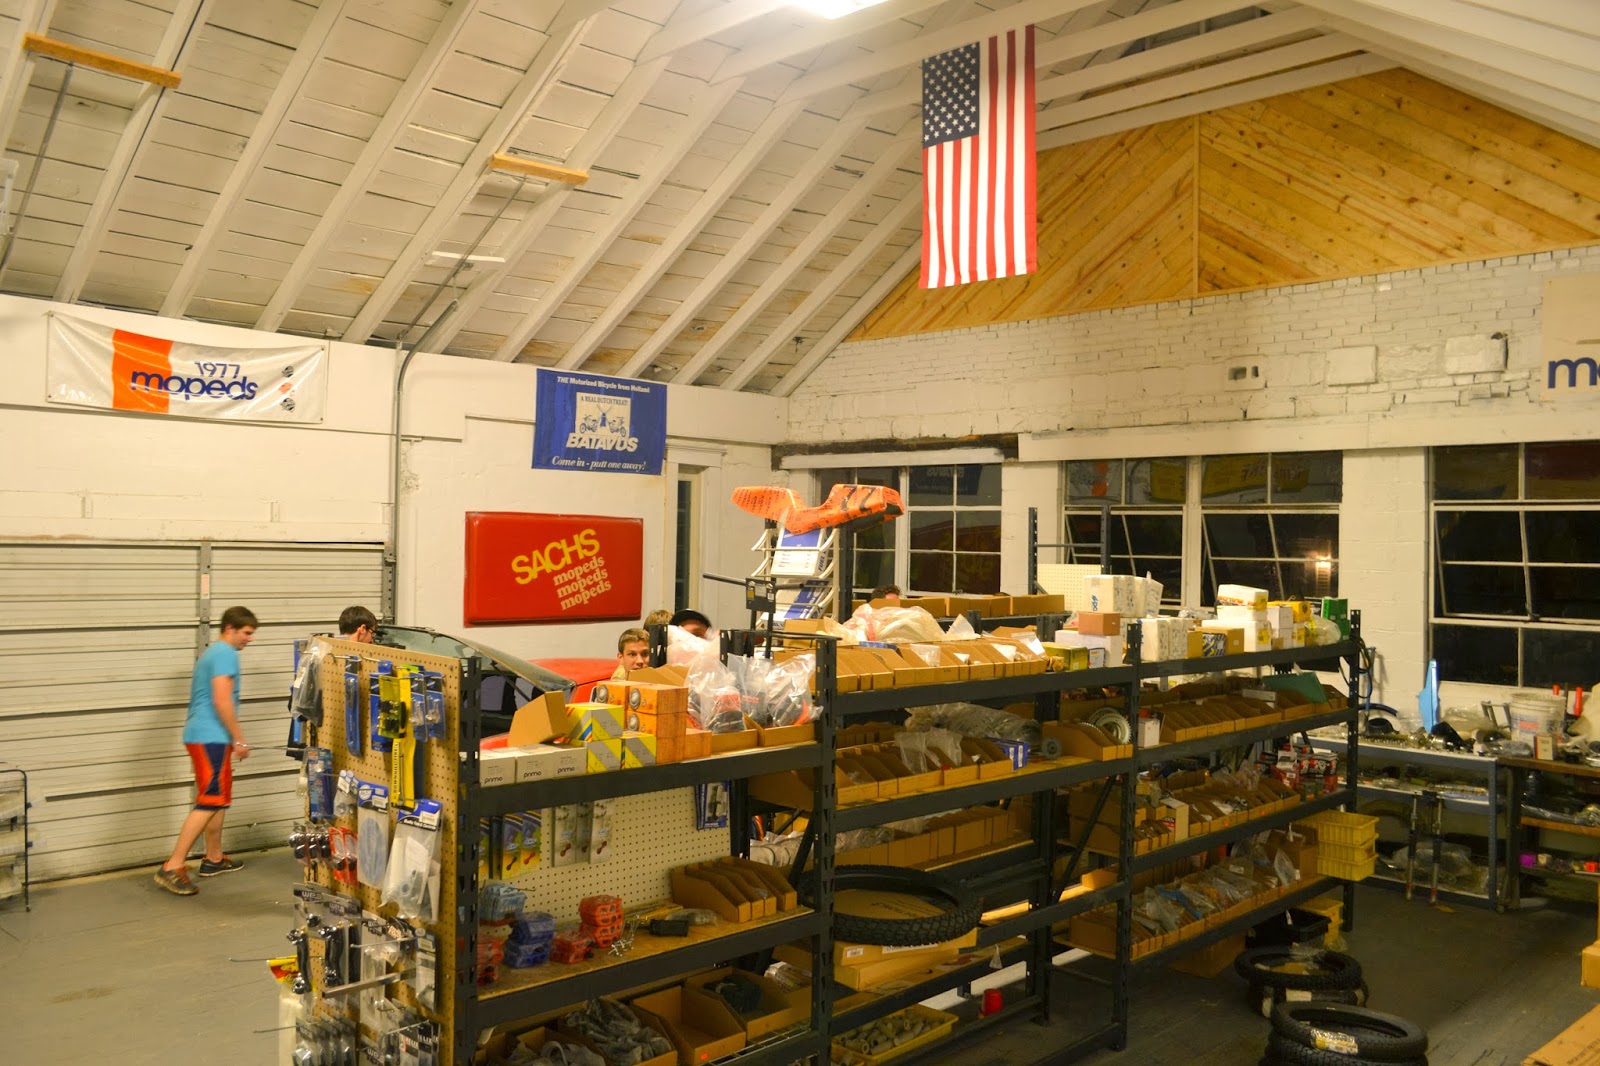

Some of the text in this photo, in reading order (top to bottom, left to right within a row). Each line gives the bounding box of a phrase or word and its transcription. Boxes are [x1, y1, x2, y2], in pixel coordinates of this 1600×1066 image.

[194, 362, 240, 379] 1977
[570, 377, 597, 387] Motorized
[598, 381, 617, 390] Bicycle
[617, 383, 630, 391] from
[631, 385, 650, 393] Holland
[1547, 357, 1600, 389] m
[131, 371, 258, 400] mopeds
[566, 432, 639, 452] BATAVUS
[552, 456, 575, 465] Come
[576, 457, 585, 467] in
[589, 460, 608, 470] putt
[622, 461, 646, 472] away!
[511, 528, 600, 585] SACHS
[553, 556, 605, 586] mopeds
[556, 568, 608, 598] mopeds
[560, 579, 612, 610] mopeds
